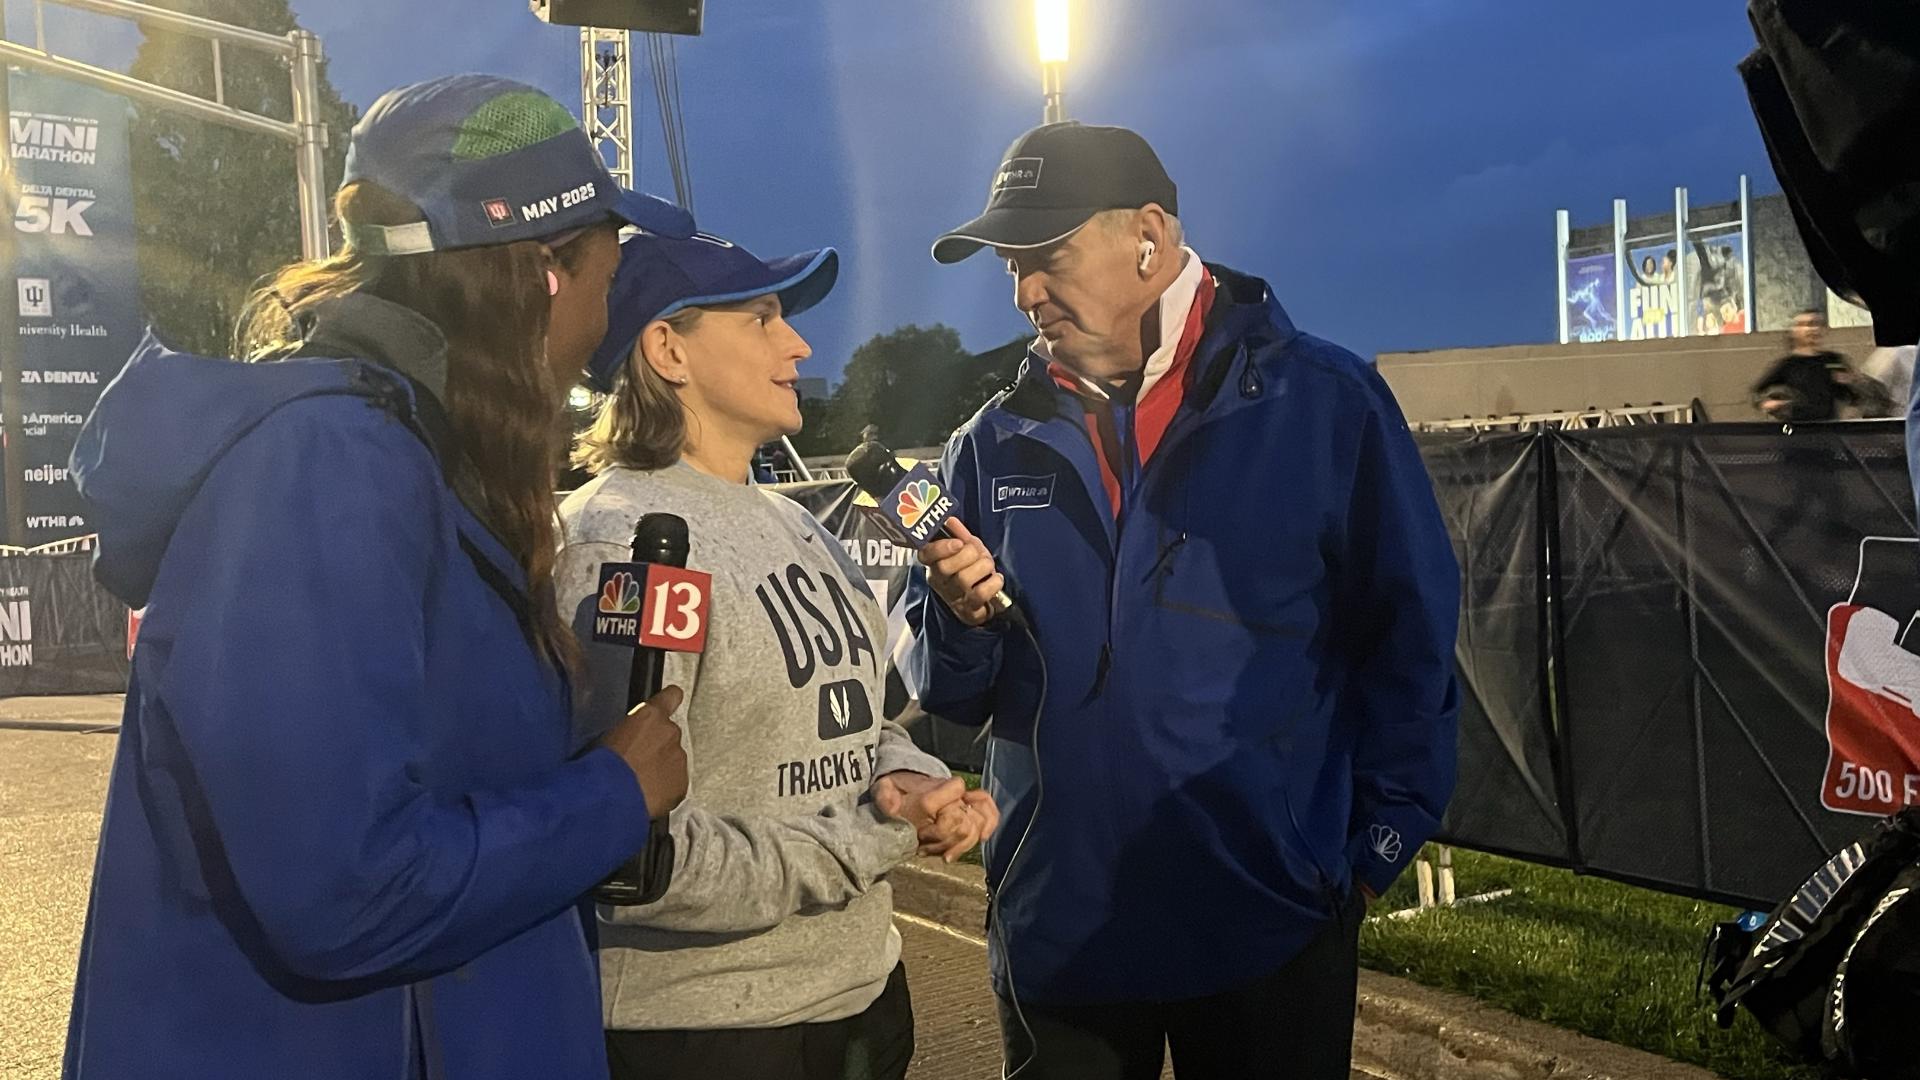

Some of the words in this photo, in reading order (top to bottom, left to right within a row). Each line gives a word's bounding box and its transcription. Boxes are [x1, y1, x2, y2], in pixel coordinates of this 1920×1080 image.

[10, 117, 98, 150] MINI
[22, 184, 53, 195] DELTA
[55, 187, 96, 199] DENTAL
[521, 196, 558, 221] MAY
[561, 182, 596, 208] 2025
[14, 196, 95, 236] 5K
[70, 324, 107, 336] Health
[43, 371, 98, 384] DENTAL
[26, 516, 67, 528] WTHR
[911, 496, 953, 540] WTHR
[596, 617, 637, 636] WTHR
[649, 581, 702, 640] 13
[755, 563, 878, 689] USA
[1835, 761, 1893, 804] 500
